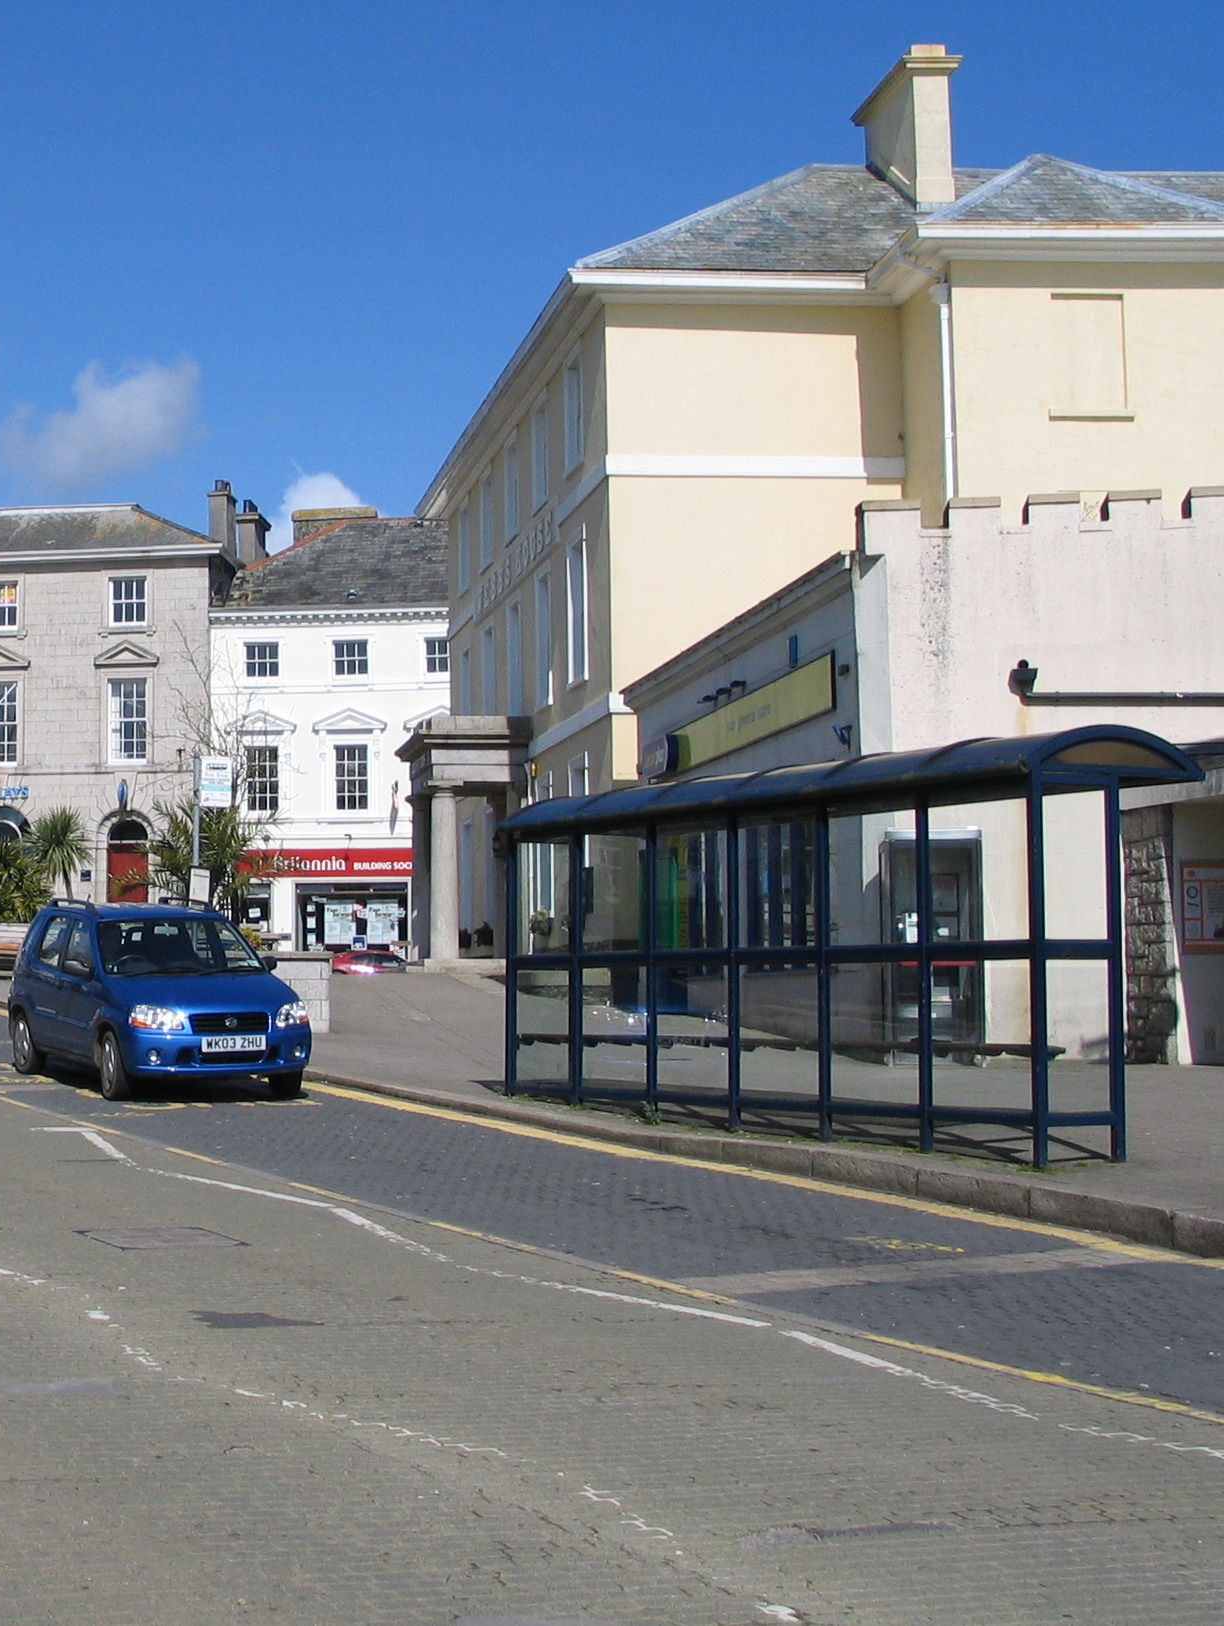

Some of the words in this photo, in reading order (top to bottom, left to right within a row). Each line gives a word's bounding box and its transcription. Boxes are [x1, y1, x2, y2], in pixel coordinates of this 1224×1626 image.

[353, 861, 392, 871] BUILDING
[206, 1036, 236, 1050] WK03
[240, 1036, 263, 1049] ZHU
